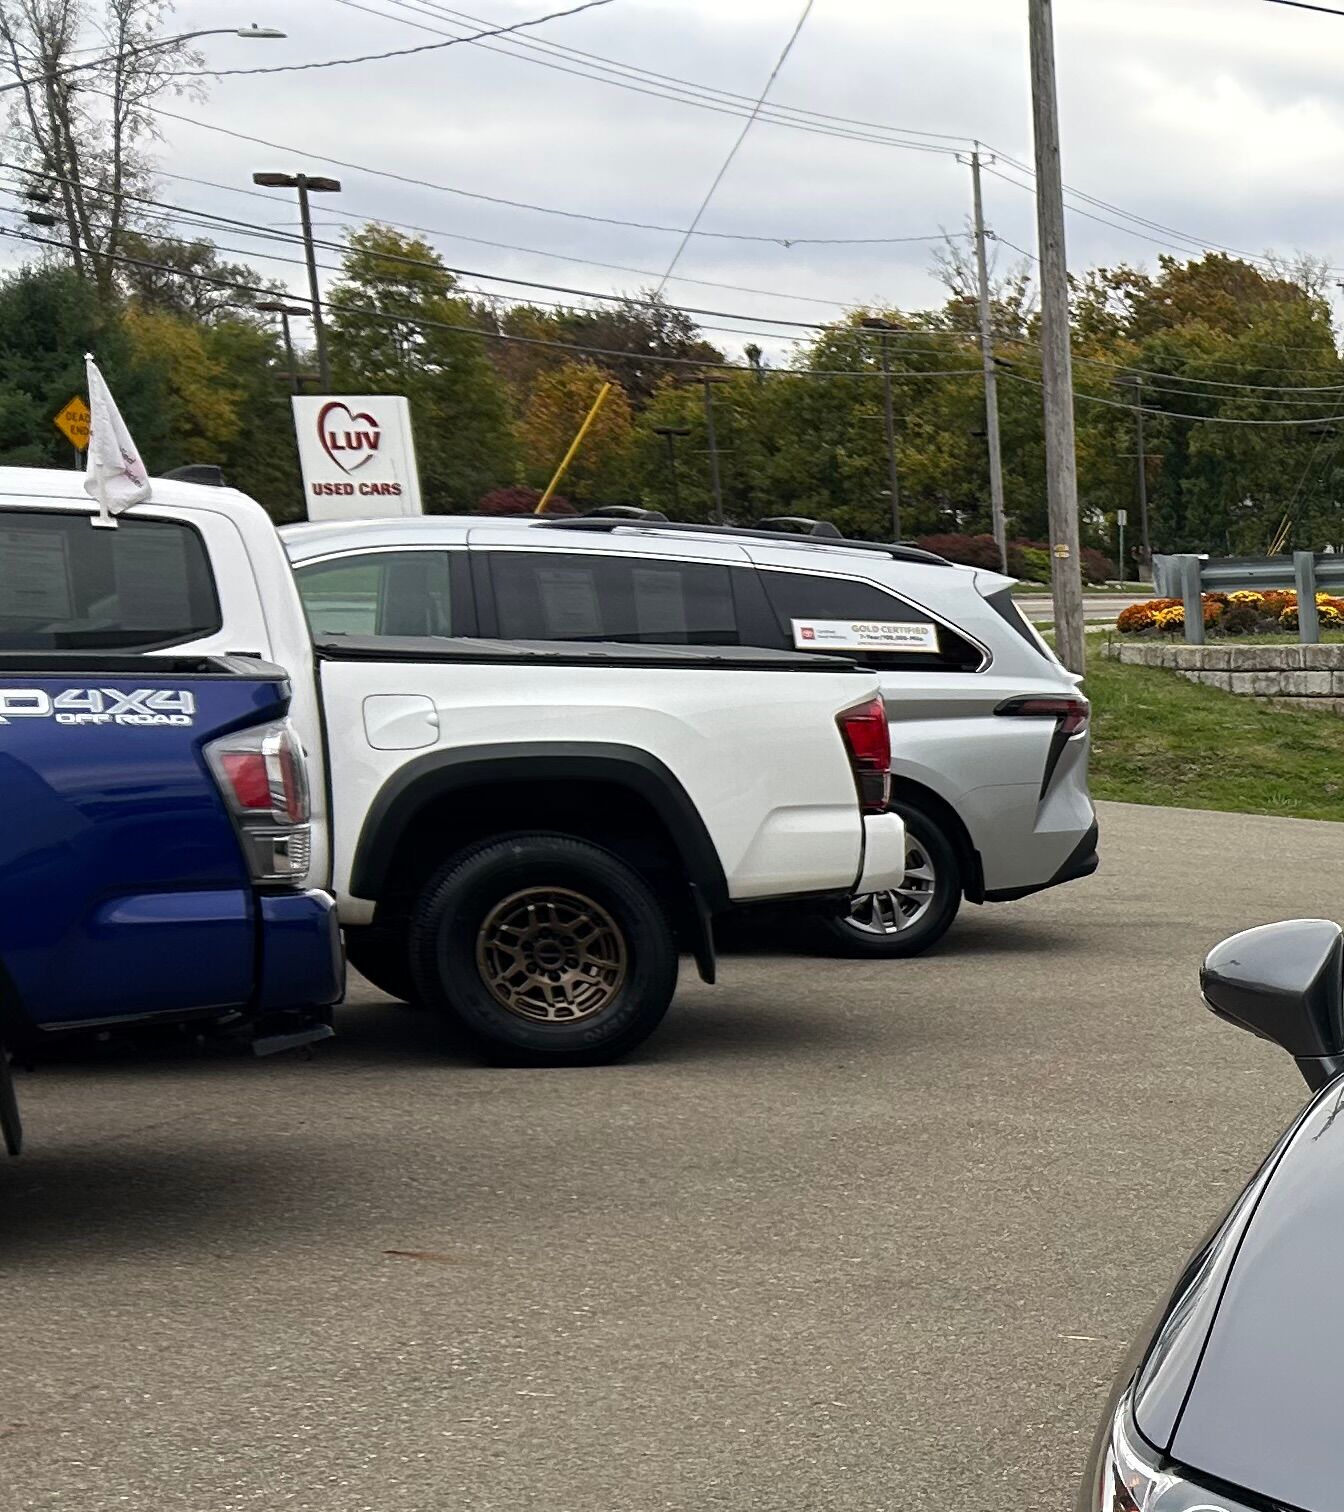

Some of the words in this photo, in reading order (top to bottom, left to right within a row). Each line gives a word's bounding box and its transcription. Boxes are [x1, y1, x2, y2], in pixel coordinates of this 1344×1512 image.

[70, 425, 91, 435] END
[328, 431, 381, 450] LUV
[312, 482, 354, 496] USED
[359, 482, 402, 496] CARS
[851, 624, 879, 633] GOLD
[881, 625, 929, 635] CERTIFIED
[54, 688, 195, 715] 4X4
[55, 713, 112, 725] OFF
[115, 714, 193, 726] ROAD
